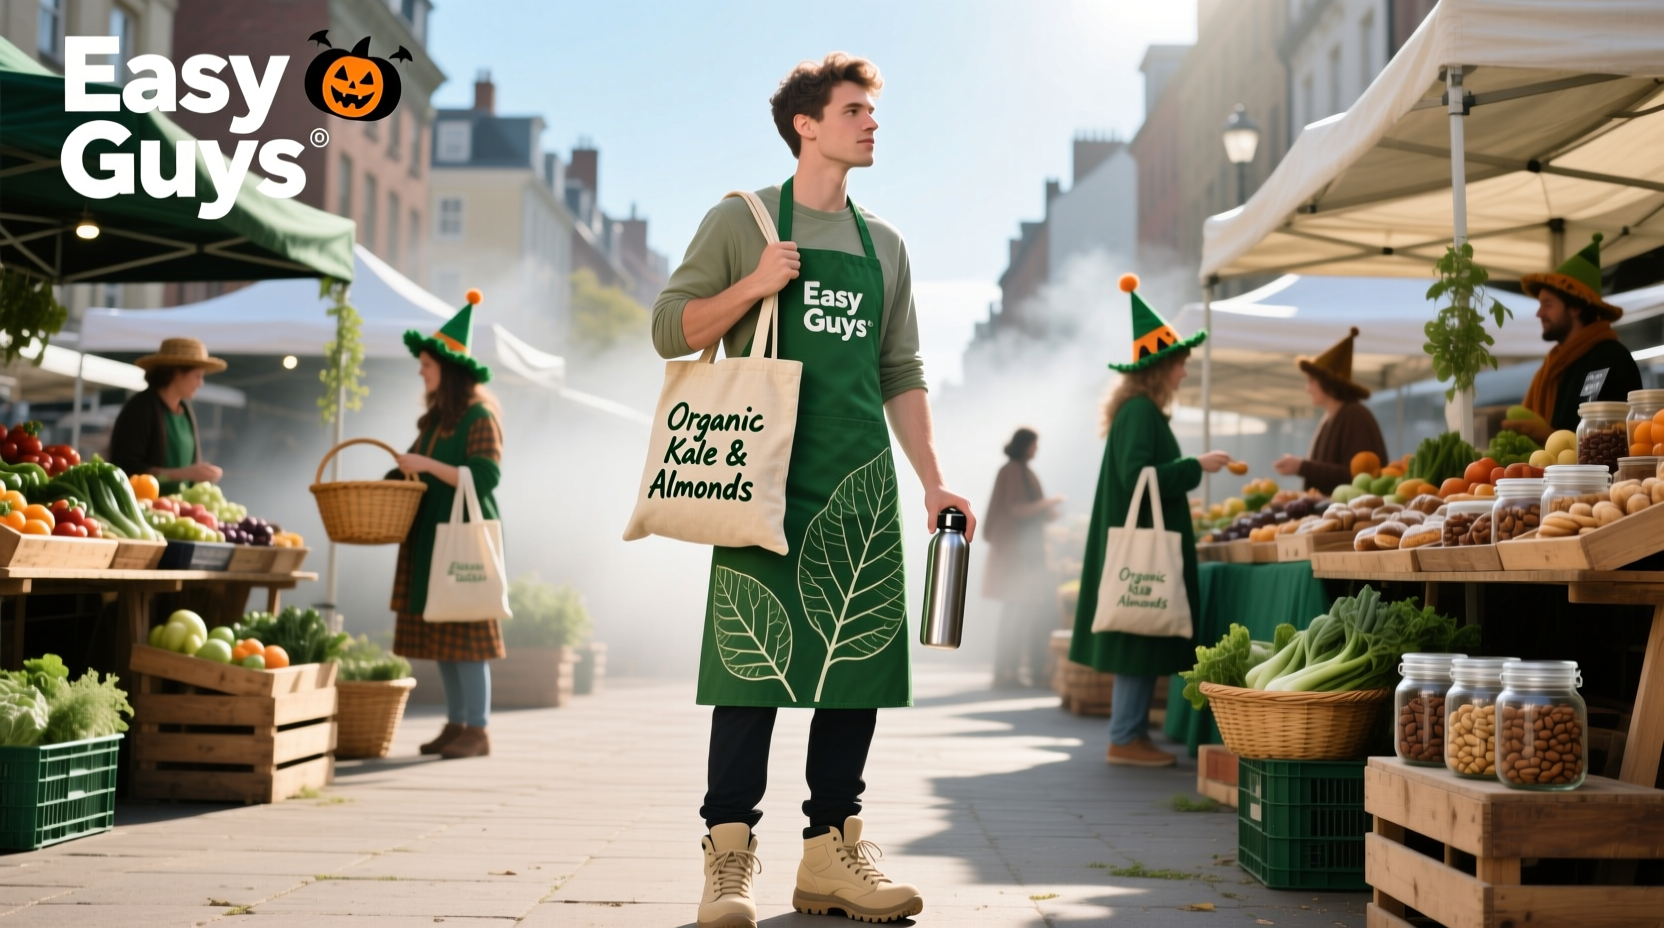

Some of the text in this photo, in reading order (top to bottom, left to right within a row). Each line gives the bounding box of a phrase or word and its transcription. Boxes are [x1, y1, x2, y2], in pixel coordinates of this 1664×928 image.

[804, 281, 863, 316] Easy
[803, 308, 867, 341] Guys
[667, 402, 764, 442] Organic
[663, 436, 748, 466] Kale &
[647, 468, 754, 502] Almonds
[1119, 567, 1166, 584] Organic
